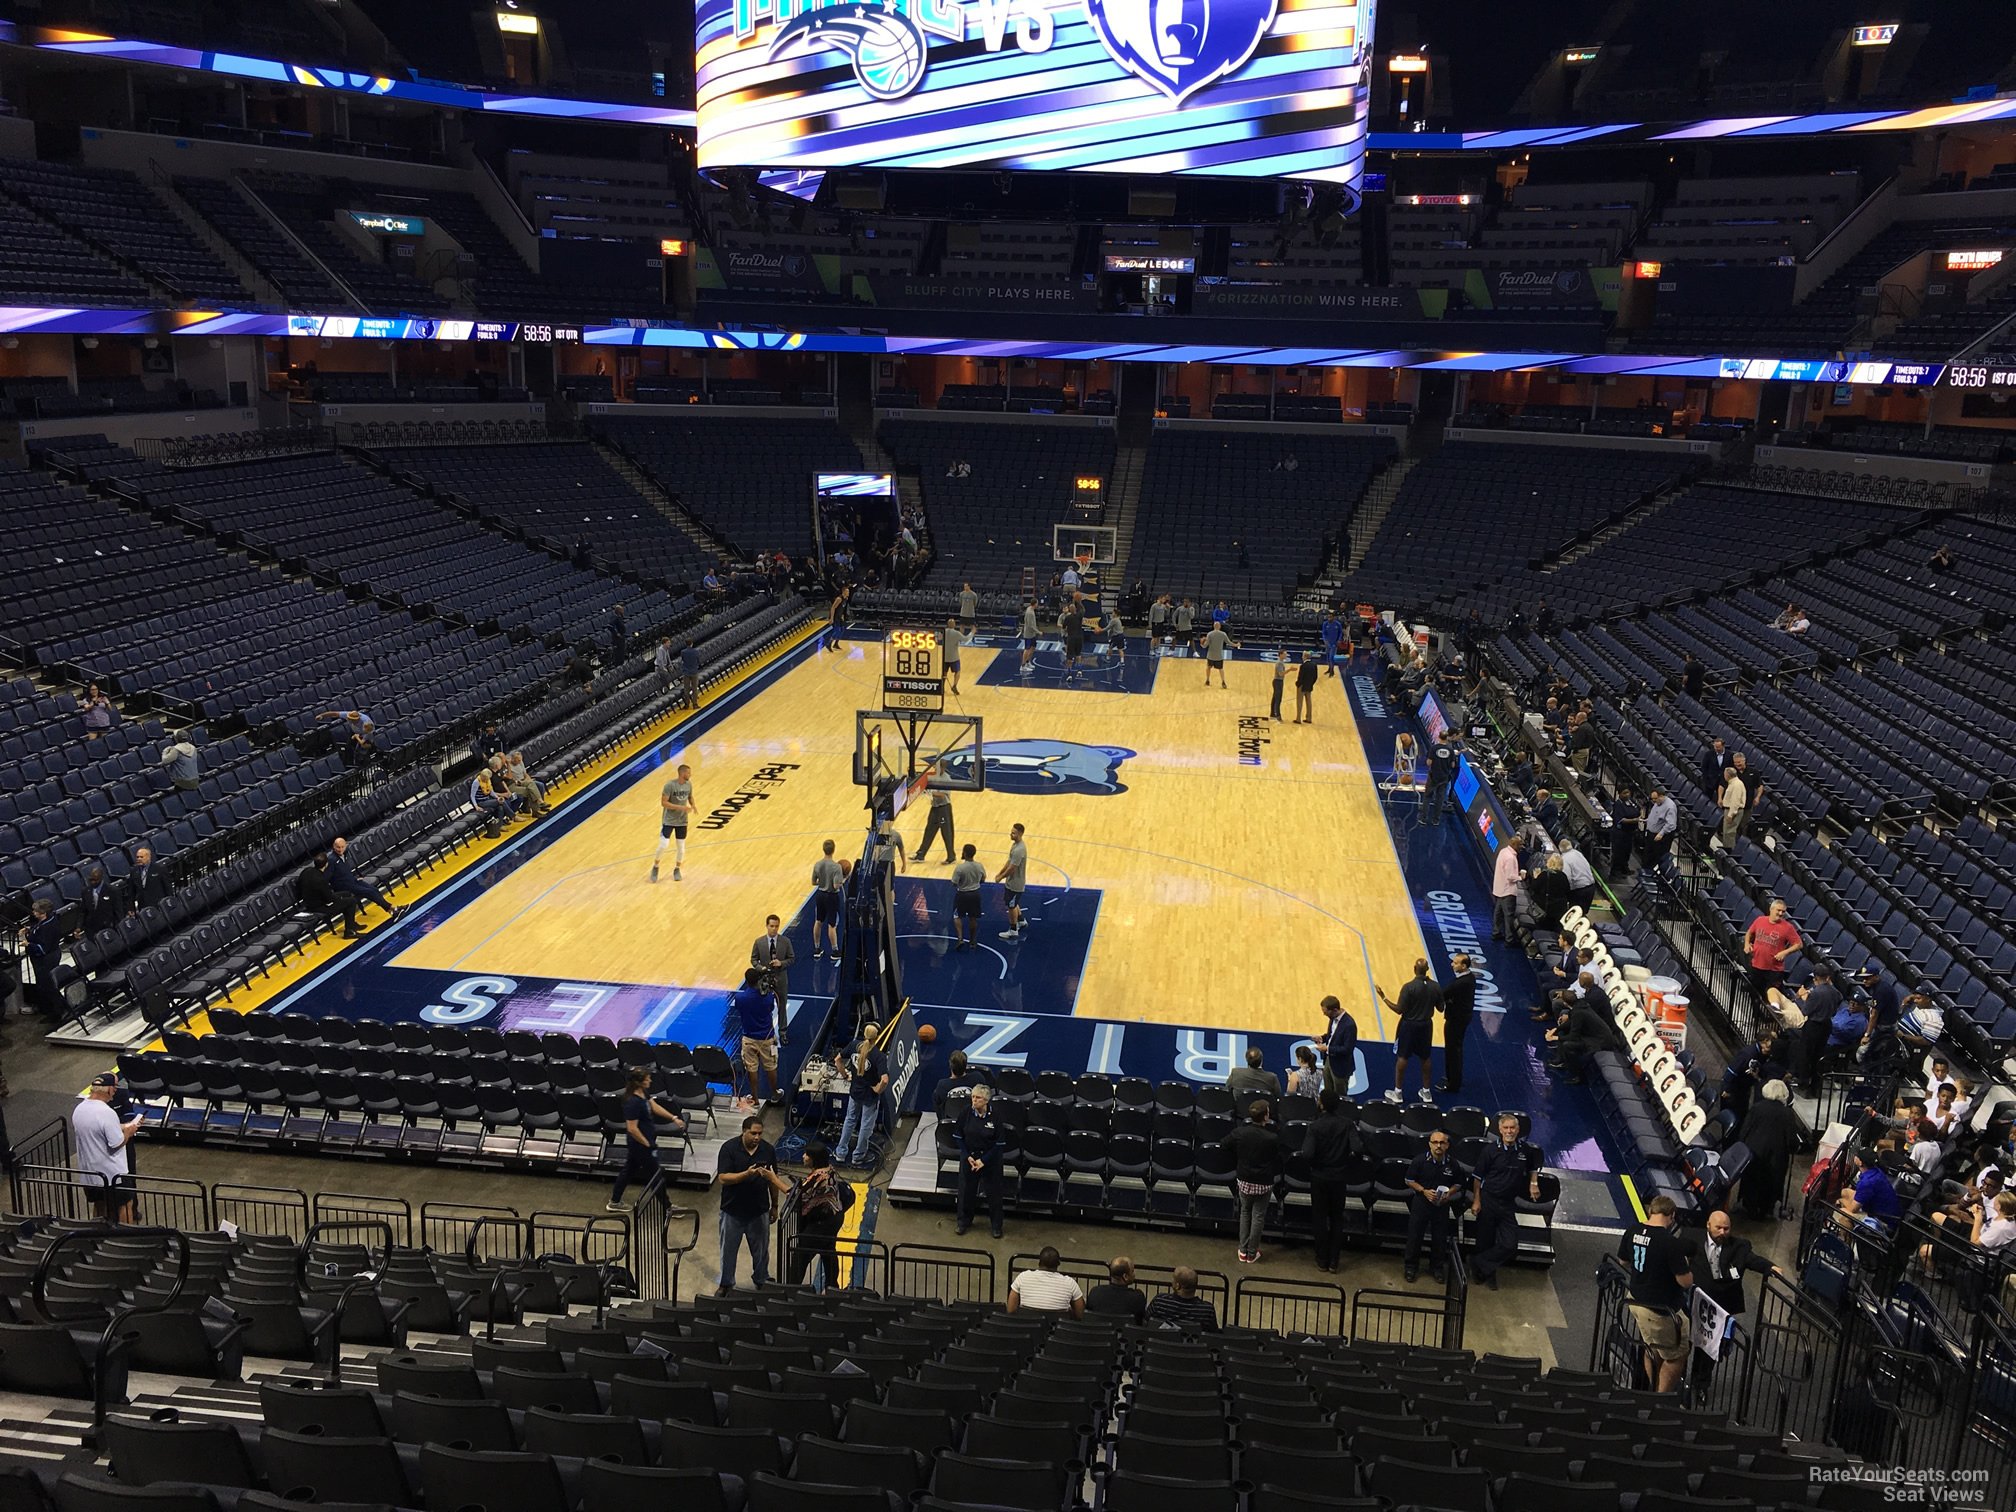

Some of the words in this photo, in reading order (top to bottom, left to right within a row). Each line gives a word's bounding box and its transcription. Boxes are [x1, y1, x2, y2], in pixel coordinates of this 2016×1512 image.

[728, 252, 784, 268] FanDuel
[1115, 259, 1148, 268] FanDuel
[1149, 260, 1184, 269] LEDGE
[1498, 271, 1558, 287] FanDuel
[904, 284, 948, 297] BLUFF
[952, 286, 983, 298] CITY
[987, 287, 1030, 299] PLAYS
[1035, 288, 1075, 300] HERE.
[1207, 292, 1314, 306] #GRIZZNATION
[1319, 295, 1355, 307] WINS
[1361, 296, 1403, 308] HERE.
[362, 320, 391, 329] TIMEOUTS:
[477, 323, 502, 332] TIMEOUTS:
[362, 328, 382, 337] FOULS:
[477, 331, 493, 340] FOULS:
[524, 325, 552, 342] 58:56
[565, 329, 578, 340] QTR
[1781, 362, 1807, 371] TIMEOUTS:
[1895, 366, 1924, 375] TIMEOUTS:
[1779, 371, 1796, 380] FOULS:
[1893, 374, 1912, 383] FOULS:
[1950, 367, 1987, 387] 58:56
[2006, 372, 2016, 386] QT
[1077, 479, 1100, 489] 58:56
[892, 631, 936, 650] 58:56
[901, 681, 939, 690] TISSOT
[696, 762, 802, 830] FedExForum
[891, 1039, 920, 1114] SPALDING
